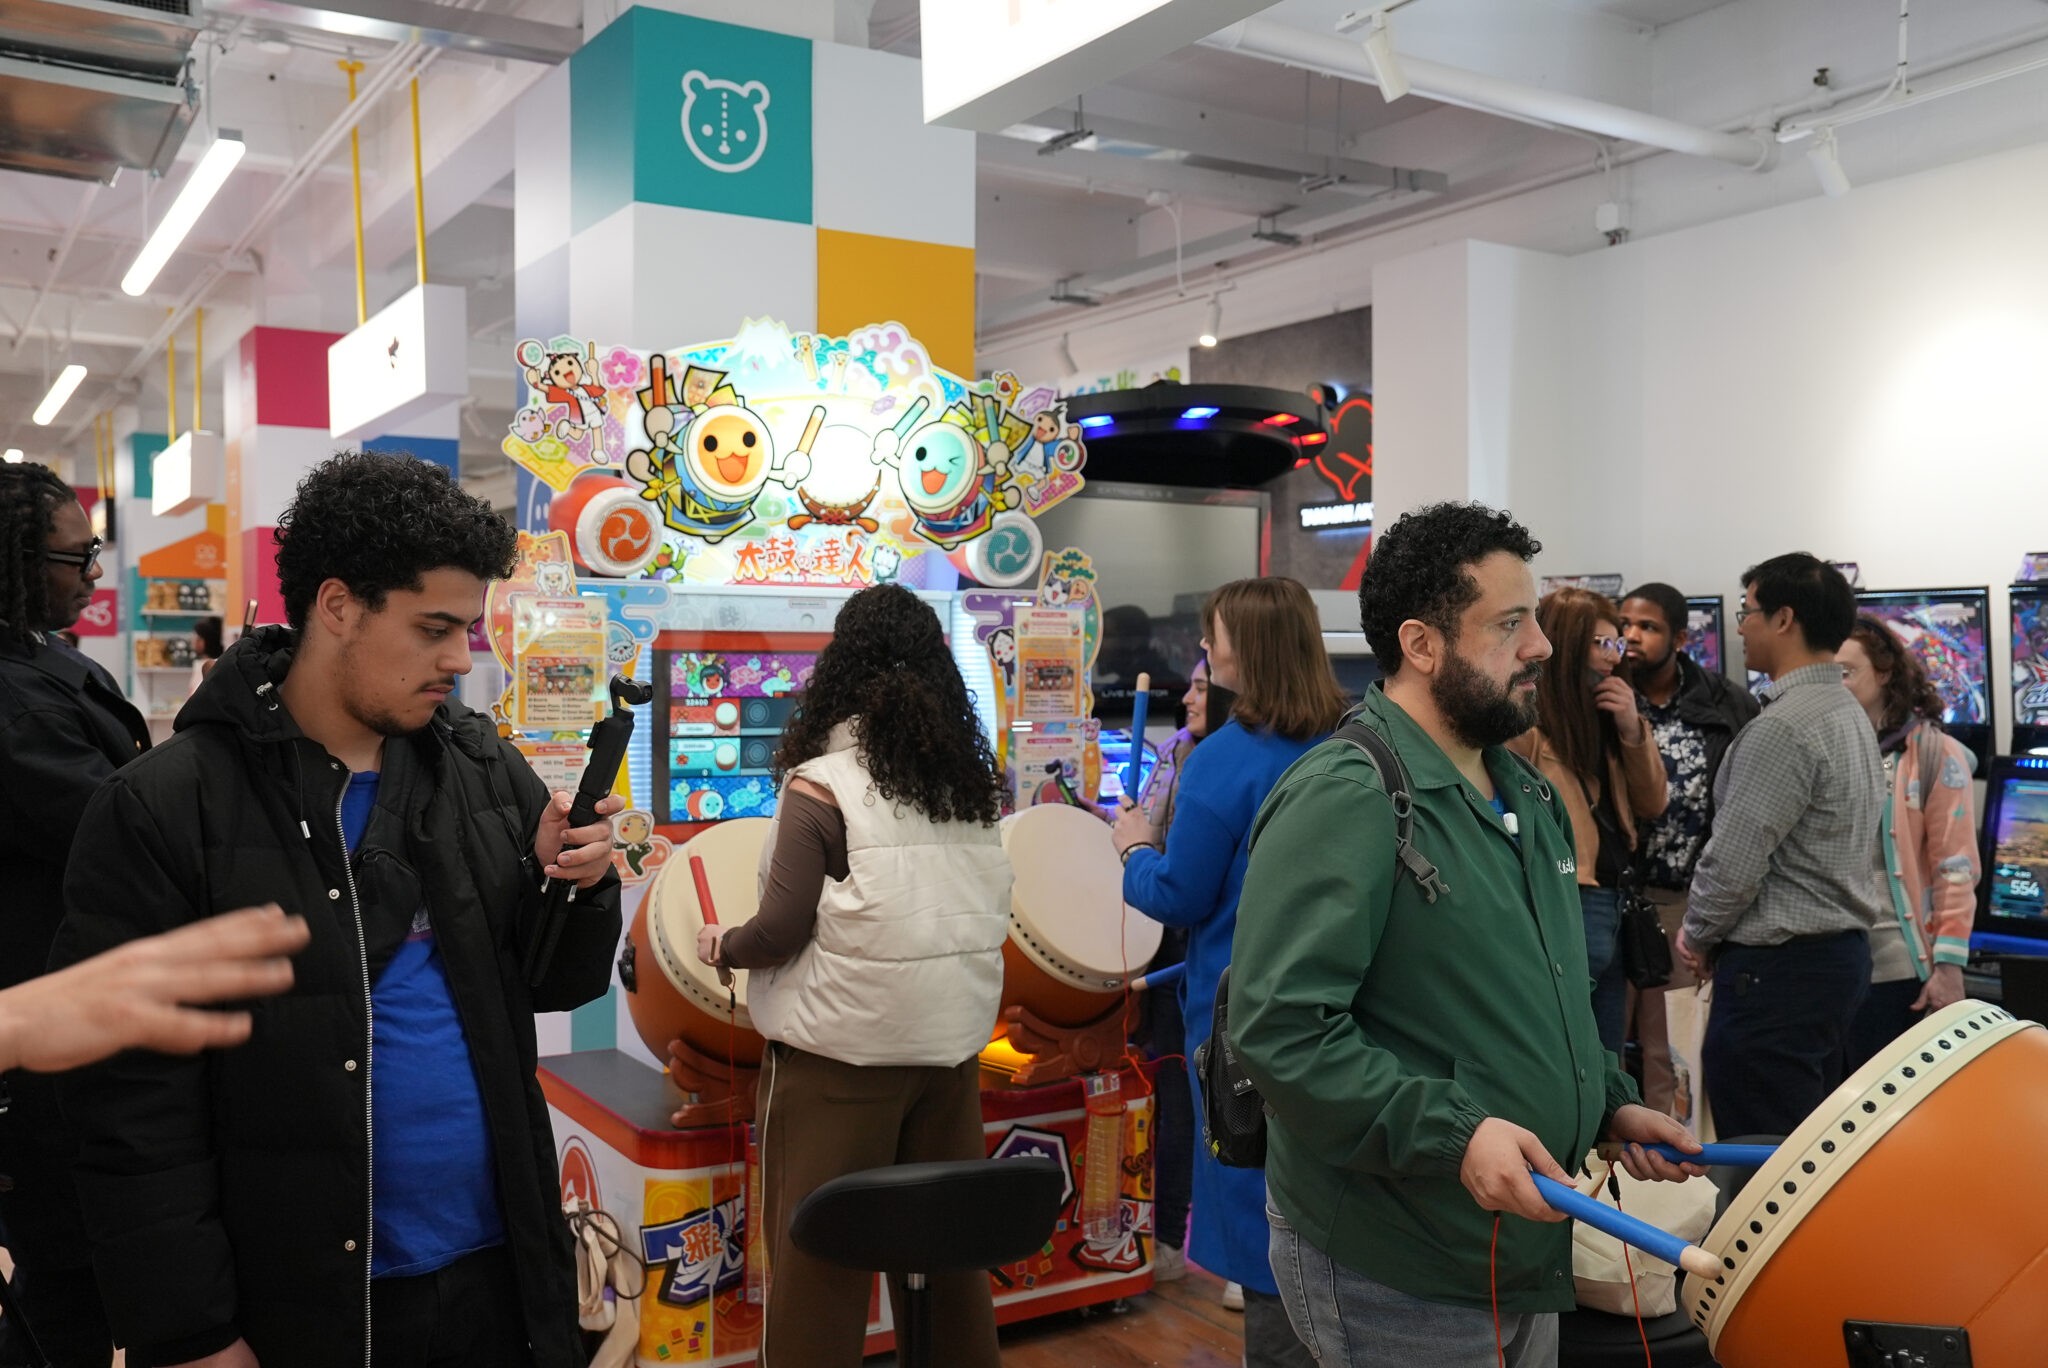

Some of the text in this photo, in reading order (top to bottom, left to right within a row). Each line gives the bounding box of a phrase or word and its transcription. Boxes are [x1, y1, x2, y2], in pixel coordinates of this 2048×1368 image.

[734, 536, 873, 584] 太鼓の達人
[1126, 689, 1169, 698] MTOR
[2010, 879, 2040, 897] 554
